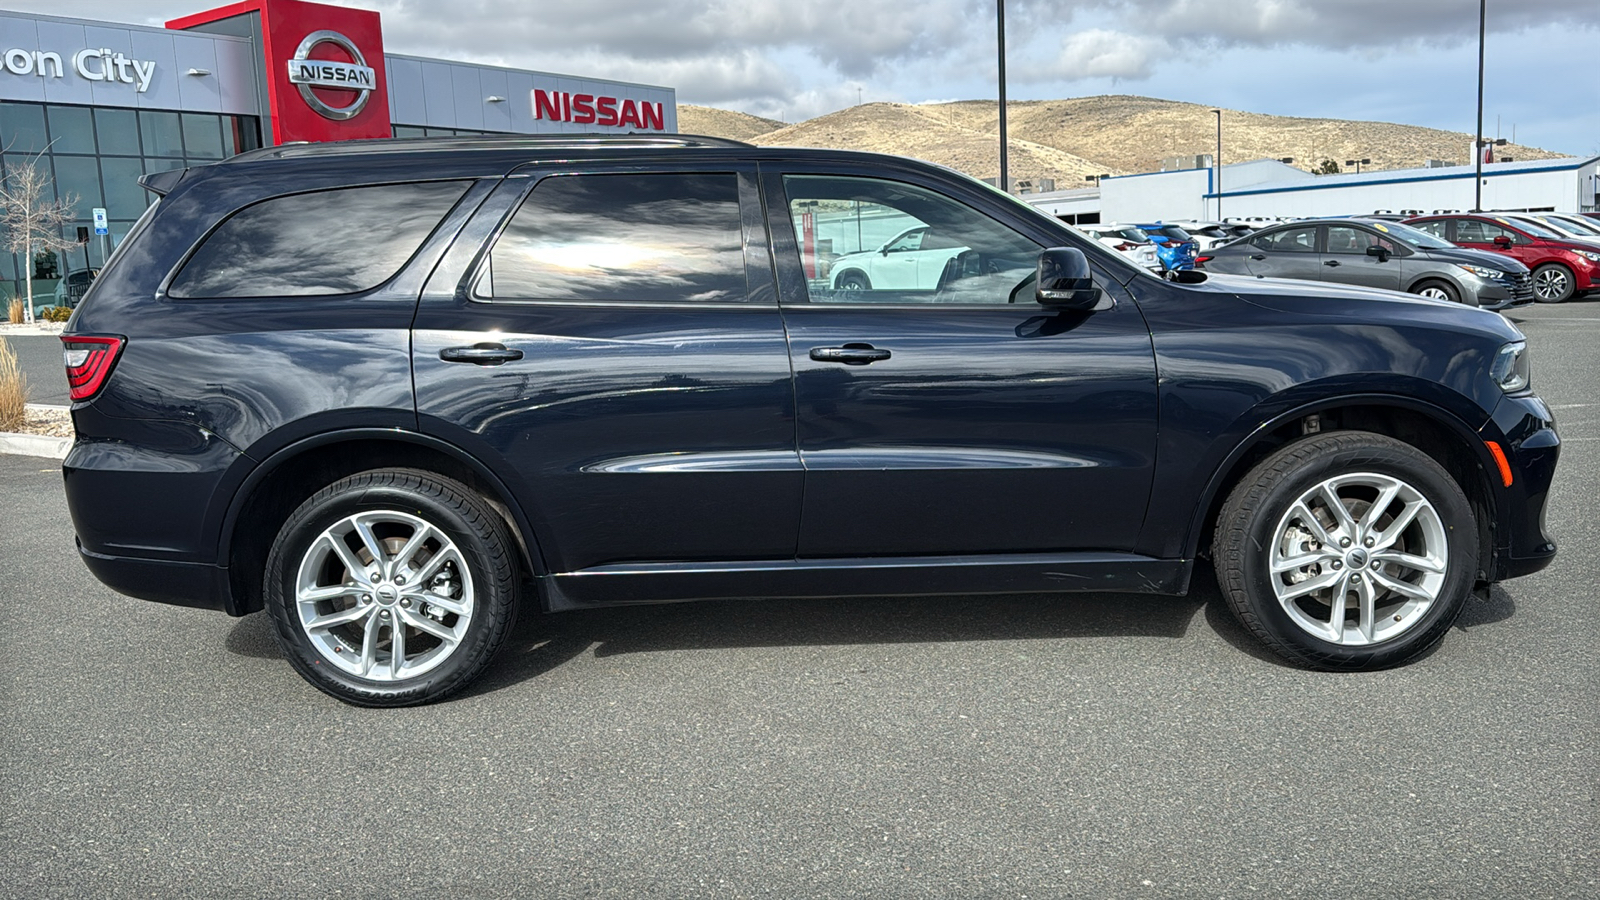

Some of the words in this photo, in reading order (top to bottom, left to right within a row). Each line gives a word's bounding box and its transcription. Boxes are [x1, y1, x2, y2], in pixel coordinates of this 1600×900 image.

[0, 48, 64, 78] on
[73, 48, 156, 92] City
[300, 65, 370, 84] NISSAN
[531, 89, 664, 130] NISSAN
